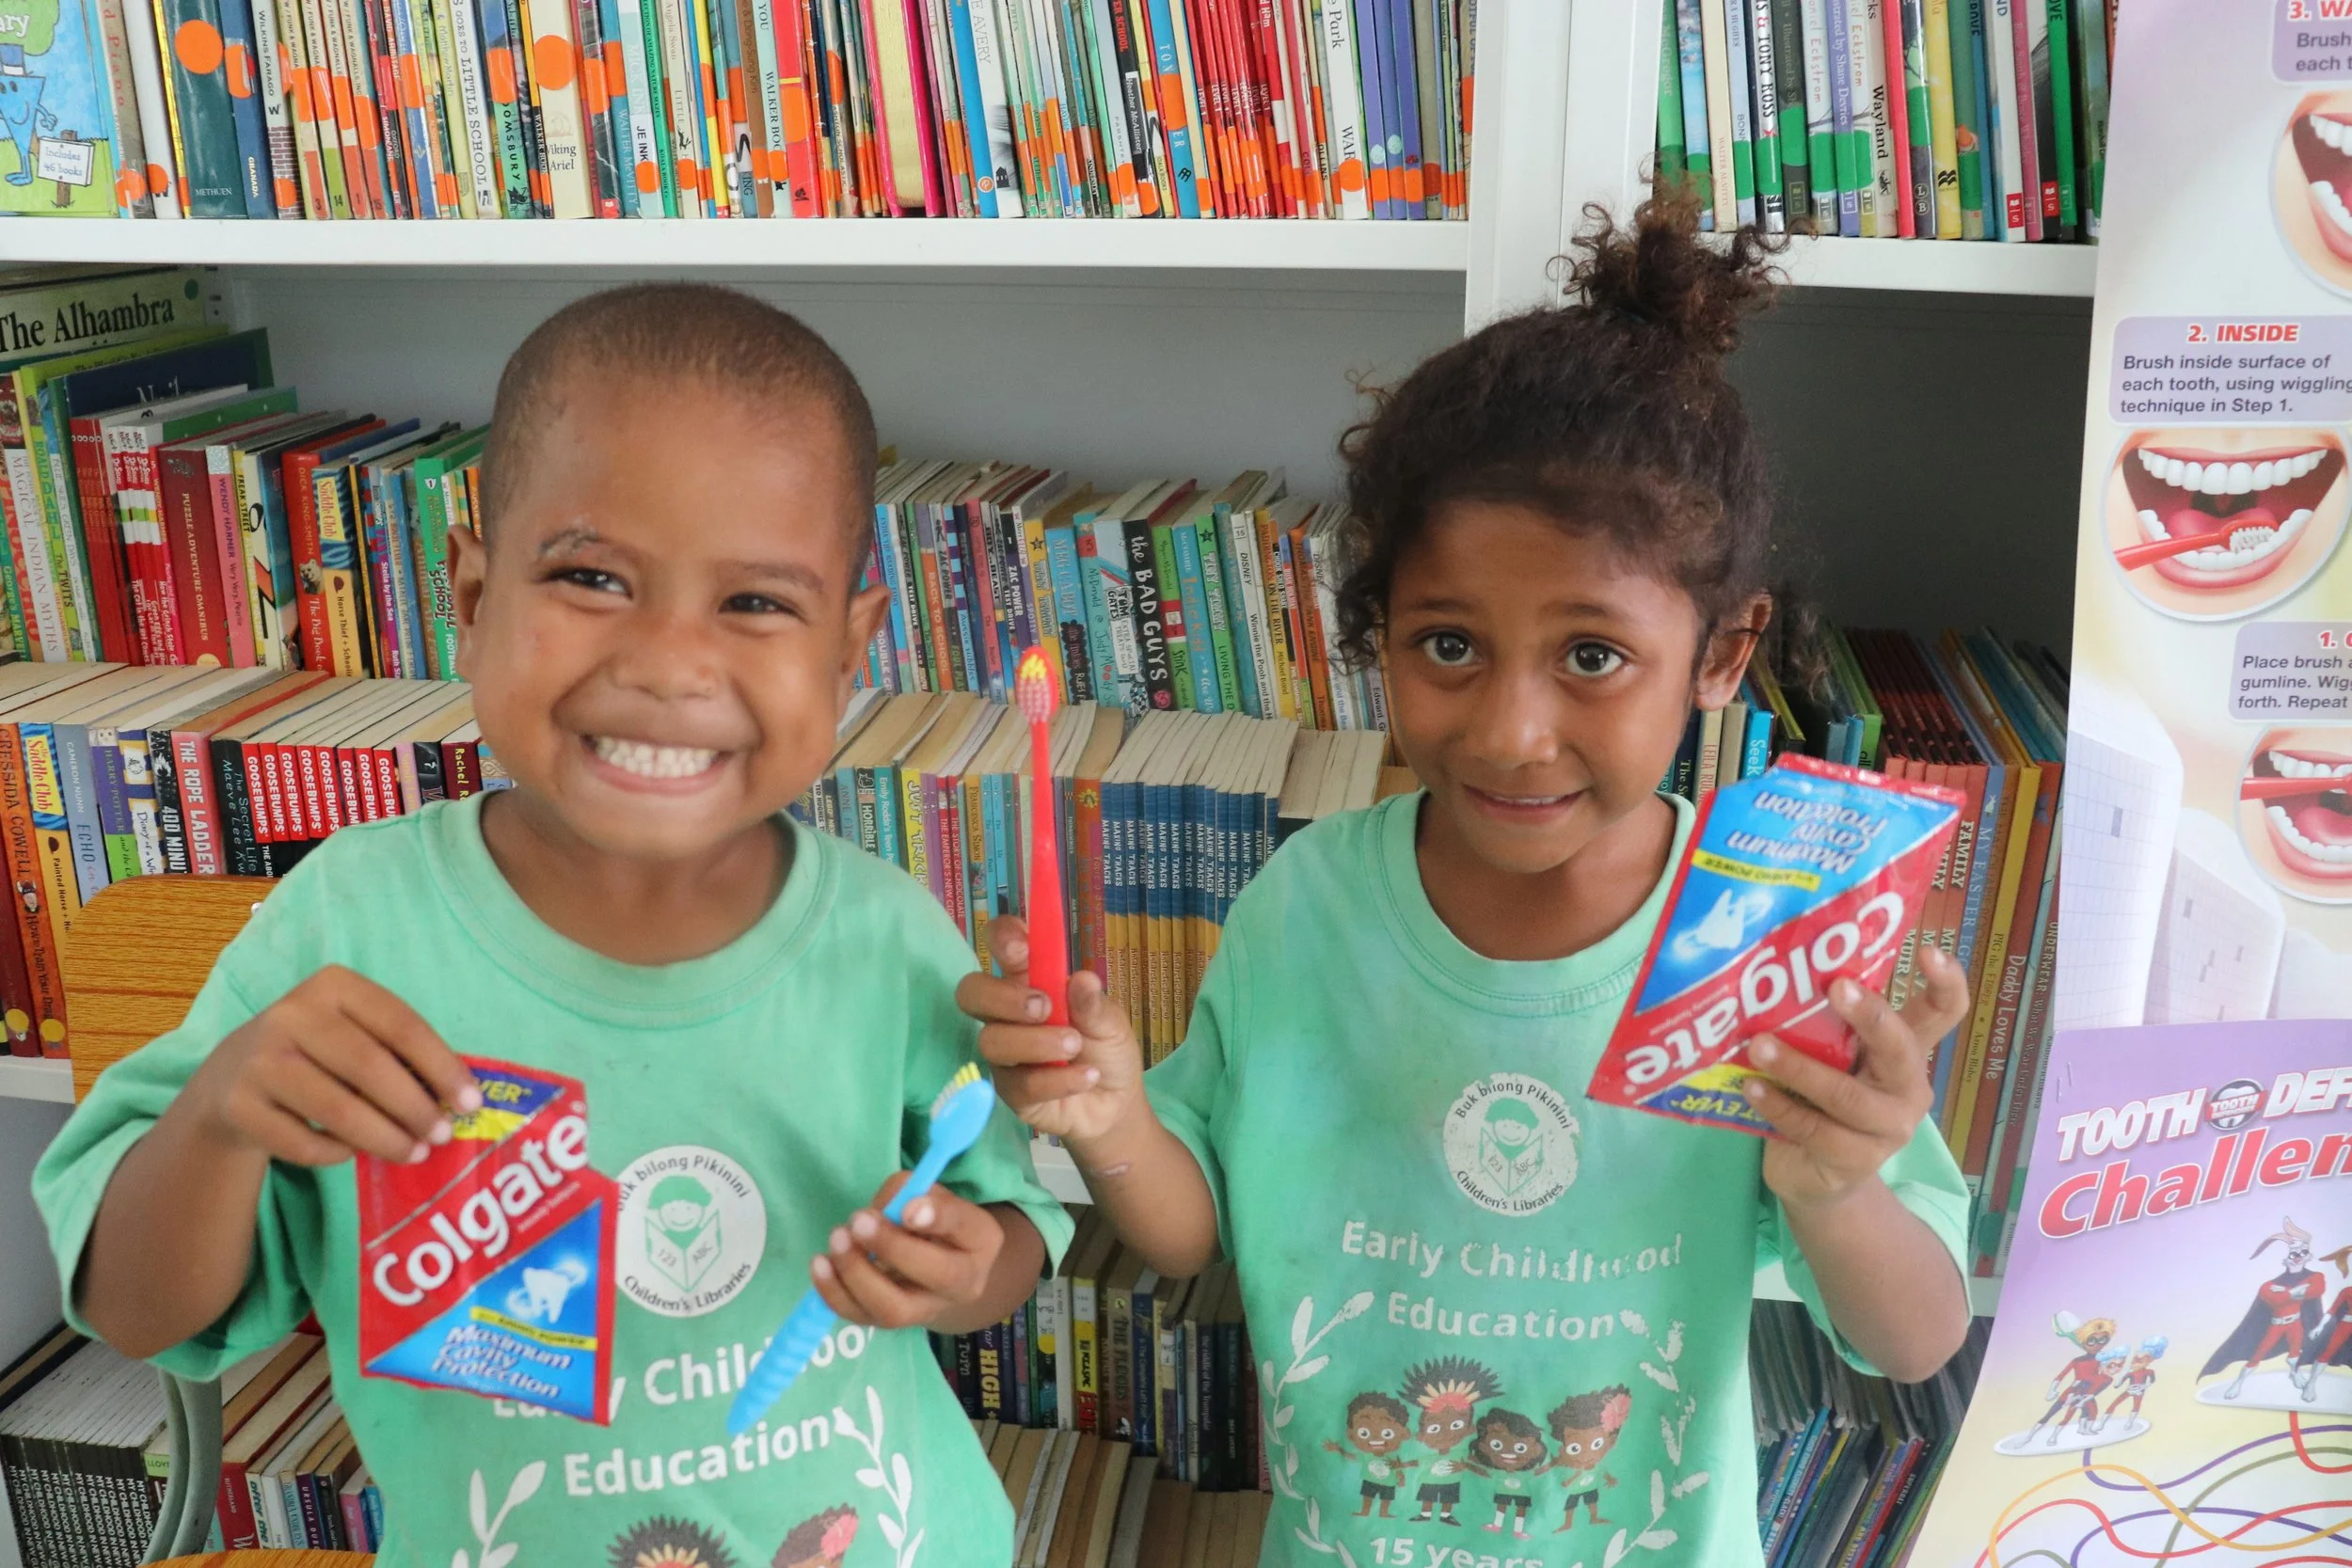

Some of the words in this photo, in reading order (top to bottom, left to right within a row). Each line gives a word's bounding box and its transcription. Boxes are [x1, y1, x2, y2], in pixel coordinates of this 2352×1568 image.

[454, 10, 467, 38] GOES
[758, 3, 770, 31] YOU
[1757, 16, 1769, 28] &
[2289, 1, 2311, 20] 3.
[258, 10, 270, 54] WILKINS
[974, 10, 991, 64] AVERY
[1115, 16, 1128, 52] SCHOOL
[1328, 10, 1345, 48] Park
[2296, 32, 2351, 49] Brush
[459, 40, 469, 54] TO
[1758, 36, 1773, 77] TONY
[1834, 40, 1848, 52] by
[262, 55, 275, 97] FARAGO
[1810, 38, 1822, 103] Eckstrom
[1836, 55, 1848, 86] Shane
[2296, 57, 2343, 72] each
[461, 57, 476, 116] LITTLE
[765, 71, 779, 123] WALKER
[1125, 78, 1136, 109] Heather
[1260, 84, 1269, 104] LEVEL
[1762, 83, 1776, 118] ROSS
[1839, 87, 1851, 126] Devries
[1871, 86, 1888, 160] Wayland
[618, 108, 631, 153] WALTER
[637, 126, 646, 140] JE
[1130, 111, 1142, 151] McAllister
[45, 145, 83, 162] Includes
[469, 120, 485, 184] SCHOOL
[547, 143, 577, 158] Viking
[549, 158, 575, 171] Ariel
[639, 142, 650, 162] INK
[56, 165, 84, 178] books
[623, 156, 638, 204] McVITTY
[195, 186, 233, 197] METHUEN
[0, 311, 45, 353] The
[54, 293, 175, 344] Alhambra
[2186, 325, 2208, 342] 2.
[2217, 325, 2300, 342] INSIDE
[2123, 355, 2174, 370] Brush
[2180, 355, 2233, 370] inside
[2238, 354, 2307, 370] surface
[2312, 354, 2332, 369] of
[2122, 377, 2163, 392] each
[2169, 375, 2220, 393] tooth,
[2226, 377, 2275, 395] using
[2280, 375, 2352, 394] wiggling
[2120, 400, 2205, 417] technique
[2211, 400, 2226, 412] in
[2232, 399, 2273, 416] Step
[2280, 400, 2294, 412] 1.
[182, 493, 194, 531] PUZZLE
[319, 481, 335, 515] Saddle
[218, 478, 231, 515] WENDY
[225, 517, 235, 558] HARMER
[323, 515, 337, 538] Club
[11, 455, 36, 529] MAGICAL
[27, 535, 49, 594] INDIAN
[40, 602, 59, 653] MYTHS
[187, 531, 202, 592] ADVENTURE
[1131, 535, 1149, 562] the
[381, 562, 389, 582] Stella
[1240, 552, 1251, 585] DISNEY
[383, 584, 391, 593] by
[385, 594, 393, 607] the
[928, 572, 939, 605] BACK
[1107, 590, 1119, 620] GATES
[1118, 591, 1128, 616] TOM
[1135, 569, 1158, 614] BAD
[196, 594, 209, 641] OMNIBUS
[337, 596, 346, 618] Horse
[386, 608, 394, 621] Sea
[933, 609, 942, 623] TO
[340, 619, 348, 639] Thief
[1249, 613, 1260, 641] Winnie
[2318, 631, 2338, 648] 1.
[936, 627, 948, 674] SCHOOL
[1143, 621, 1168, 681] GUYS
[1254, 644, 1263, 657] the
[2243, 656, 2288, 669] Place
[2294, 655, 2343, 669] brush
[1256, 659, 1266, 679] Pooh
[2240, 675, 2312, 692] gumline.
[2238, 695, 2281, 709] forth.
[2287, 696, 2347, 711] Repeat
[179, 741, 195, 764] THE
[454, 748, 469, 784] Rachel
[1701, 744, 1718, 769] LEILA
[1747, 739, 1764, 776] Seek
[67, 741, 80, 784] CAMERON
[75, 785, 85, 814] NUNN
[183, 767, 203, 804] ROPE
[264, 754, 285, 833] GOOSEBUMPS
[281, 752, 302, 833] GOOSEBUMPS
[880, 777, 890, 799] Emily
[0, 729, 20, 809] CRESSIDA
[10, 816, 27, 877] COWELL
[247, 756, 268, 835] GOOSEBUMPS
[908, 781, 922, 825] JUST
[882, 800, 892, 832] Rodda's
[951, 817, 960, 831] THE
[1753, 790, 1889, 839] Protection
[76, 824, 96, 863] ECHO
[189, 809, 217, 876] LADDER
[237, 798, 253, 846] Secret
[245, 846, 257, 873] Life
[884, 834, 893, 851] Teen
[952, 833, 962, 858] STORY
[1112, 821, 1122, 851] MAKING
[1126, 820, 1136, 850] MAKING
[1791, 821, 1872, 857] Cavity
[1977, 826, 1994, 855] MY
[955, 860, 962, 871] OF
[1727, 830, 1857, 875] Maximum
[1951, 819, 1975, 889] FAMILY
[1114, 855, 1123, 886] TRACKS
[1127, 855, 1137, 885] TRACKS
[956, 873, 965, 919] CHOCOLATE
[1962, 860, 1987, 927] EASTER
[1624, 890, 1906, 1085] Colgate
[1998, 955, 2026, 1003] Daddy
[1989, 1006, 2014, 1054] Loves
[1984, 1057, 2004, 1081] Me
[1454, 1091, 1481, 1119] Buk
[1478, 1080, 1524, 1098] bilong
[1526, 1084, 1573, 1131] Pikinini
[2210, 1093, 2259, 1117] TOOTH
[2058, 1087, 2207, 1163] TOOTH
[637, 1155, 690, 1187] bilong
[693, 1153, 751, 1199] Pikinini
[1486, 1153, 1504, 1174] 123
[1514, 1157, 1535, 1178] ABC
[1456, 1169, 1509, 1212] Children's
[1513, 1181, 1565, 1212] Libraries
[373, 1114, 589, 1307] Colgate
[658, 1248, 677, 1269] 123
[692, 1241, 715, 1265] ABC
[1342, 1220, 1444, 1277] Early
[623, 1273, 691, 1313] Children's
[694, 1261, 753, 1309] Libraries
[1387, 1291, 1613, 1340] Education
[439, 1343, 517, 1370] Cavity
[444, 1323, 573, 1370] Maximum
[431, 1356, 561, 1400] Protection
[644, 1323, 875, 1405] Chiloo
[979, 1348, 1001, 1409] HIGH
[564, 1414, 831, 1497] Education
[13, 1479, 29, 1526] CHILDHOOD
[302, 1486, 315, 1522] URSULA
[1369, 1536, 1416, 1564] 15
